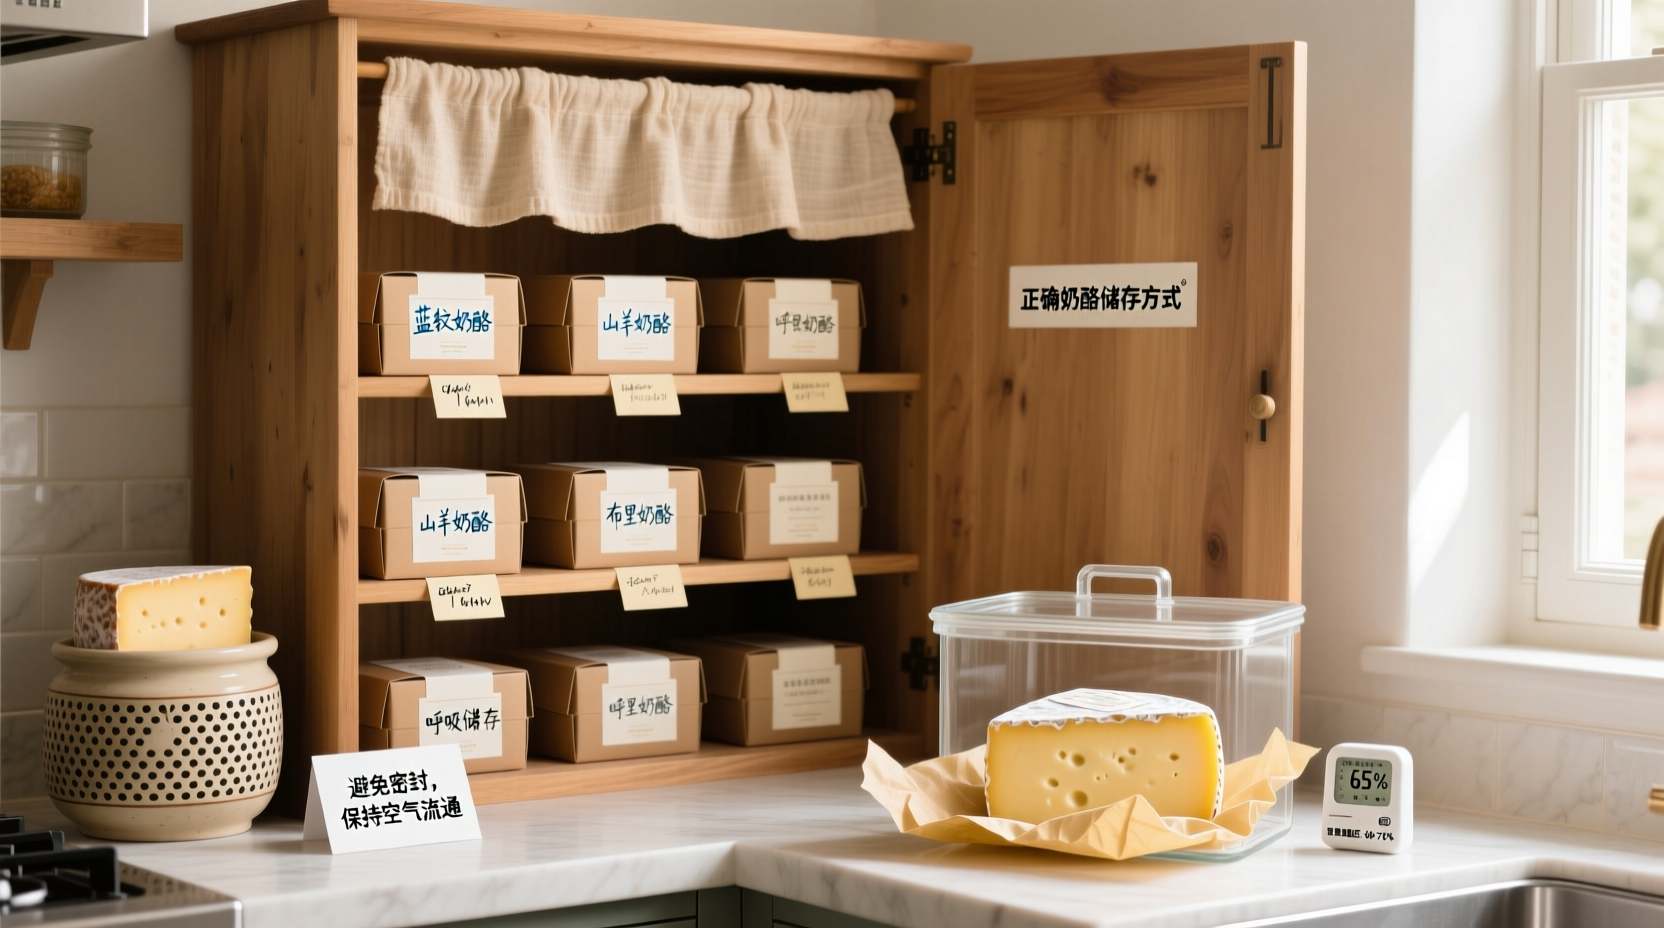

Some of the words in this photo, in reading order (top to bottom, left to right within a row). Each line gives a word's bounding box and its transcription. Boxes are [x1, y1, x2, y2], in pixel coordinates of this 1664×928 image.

[1021, 285, 1182, 311] 正确奶酪储存方式
[603, 308, 672, 337] 山羊奶酪
[420, 507, 493, 537] 山羊奶酪
[606, 502, 674, 531] 布里奶酪
[425, 707, 501, 736] 呼吸储存
[1350, 769, 1388, 790] 65%
[341, 795, 464, 830] 保持空气流通
